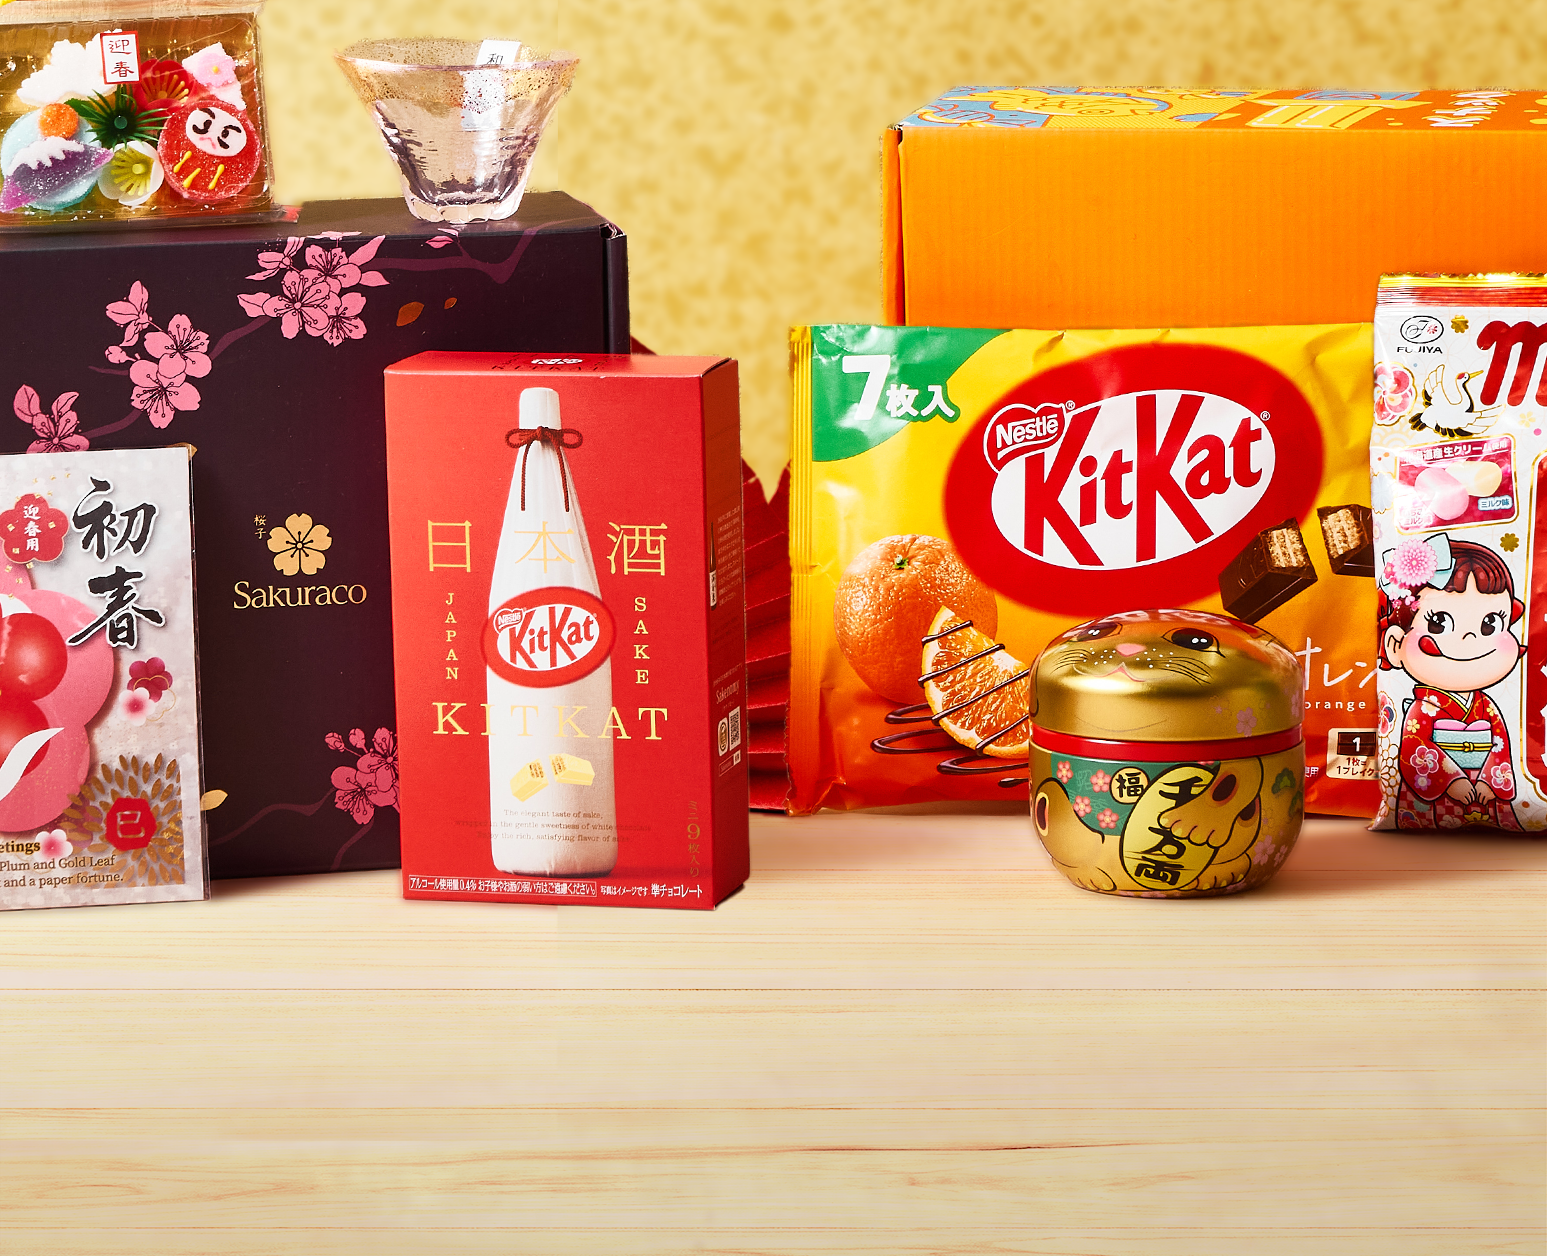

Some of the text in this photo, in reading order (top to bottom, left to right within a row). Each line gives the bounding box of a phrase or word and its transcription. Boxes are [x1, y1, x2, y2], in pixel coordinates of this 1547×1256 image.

[108, 39, 134, 78] 迎春
[1396, 346, 1443, 354] FUJIYA
[842, 354, 956, 421] 7枚入
[996, 413, 1059, 448] Nestlé
[1023, 393, 1263, 567] KitKat
[23, 504, 42, 552] 迎春用
[254, 514, 267, 540] 桜子
[67, 476, 164, 647] 初春
[427, 519, 668, 576] 日本酒
[233, 580, 367, 609] Sakuraco
[445, 592, 459, 680] JAPAN
[508, 605, 595, 669] KitKat
[633, 596, 651, 685] SAKE
[432, 701, 669, 741] KITKAT
[1352, 736, 1361, 752] 1
[1115, 772, 1144, 798] 福
[591, 823, 613, 831] white
[0, 854, 116, 872] Plum and Gold Leaf
[3, 875, 26, 888] and
[29, 878, 36, 887] a
[39, 876, 73, 889] paper
[76, 872, 124, 885] fortune.
[651, 883, 703, 899] 準チョコレート
